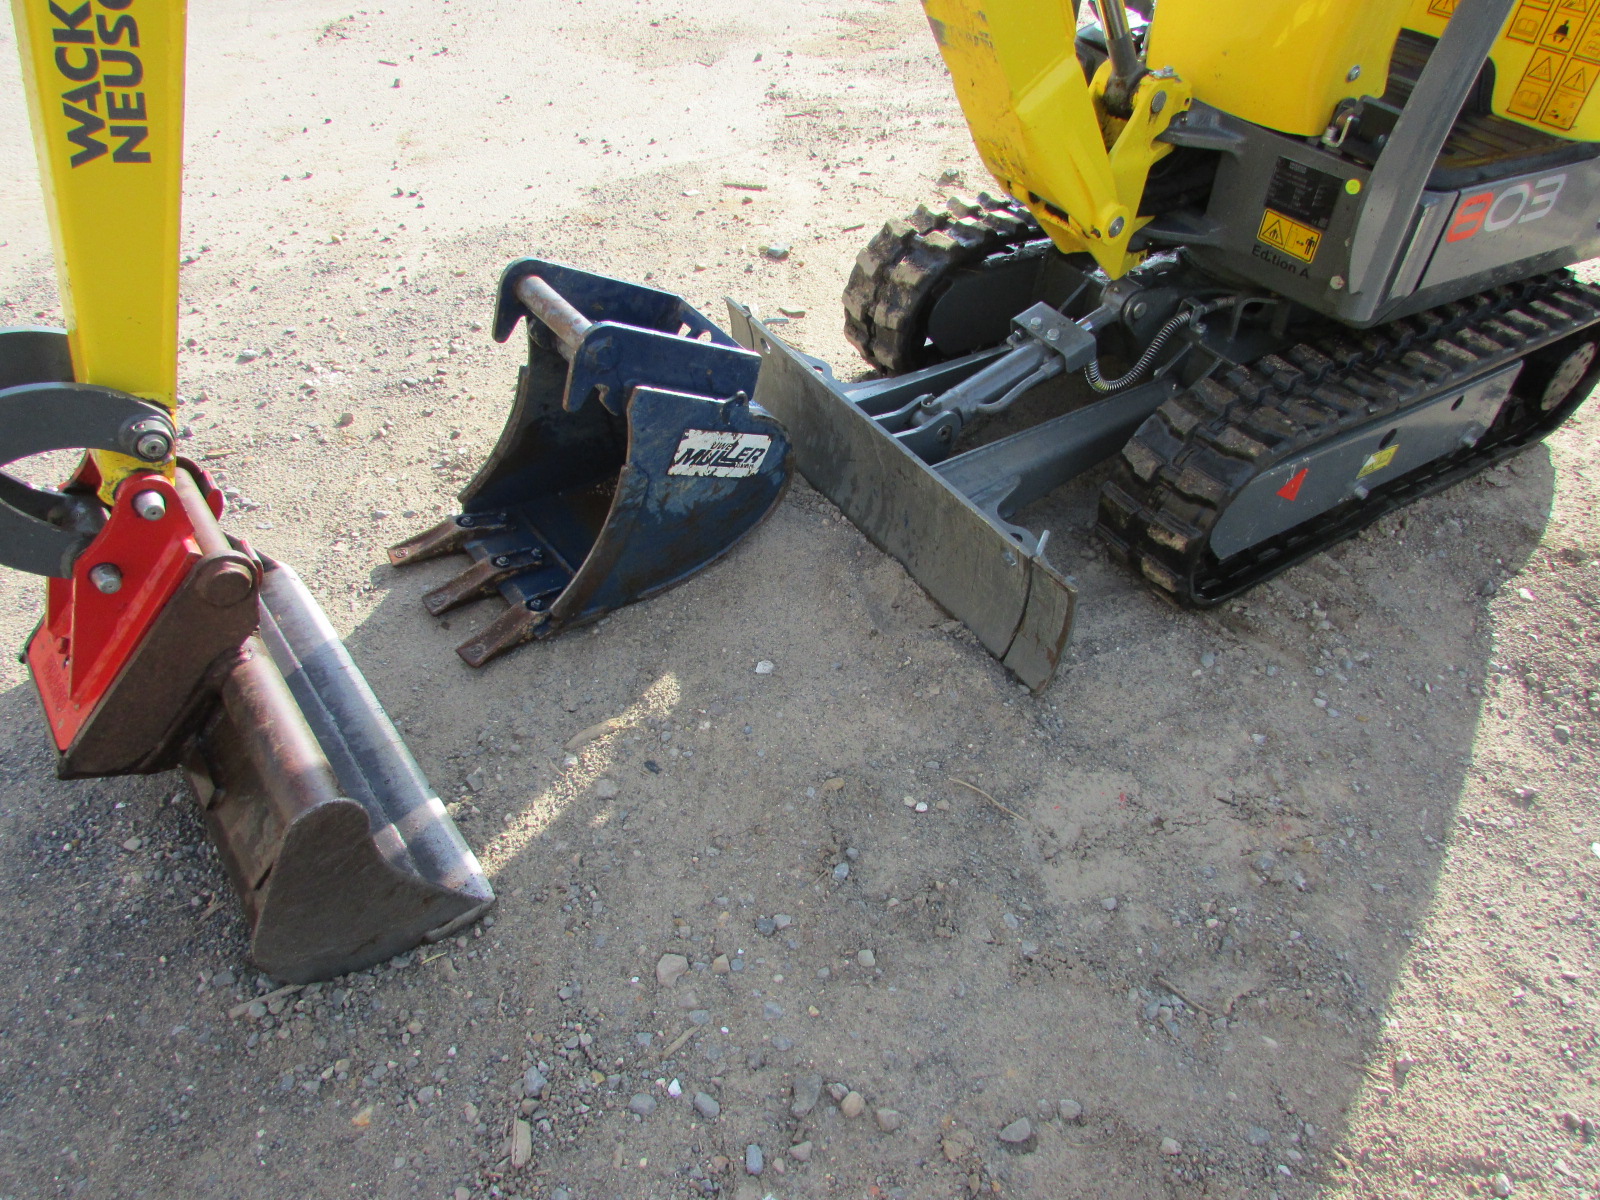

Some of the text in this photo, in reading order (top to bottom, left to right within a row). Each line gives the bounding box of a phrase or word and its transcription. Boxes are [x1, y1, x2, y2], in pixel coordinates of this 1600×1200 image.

[48, 0, 108, 169] WACK
[1445, 173, 1566, 243] 803
[1299, 267, 1309, 279] A
